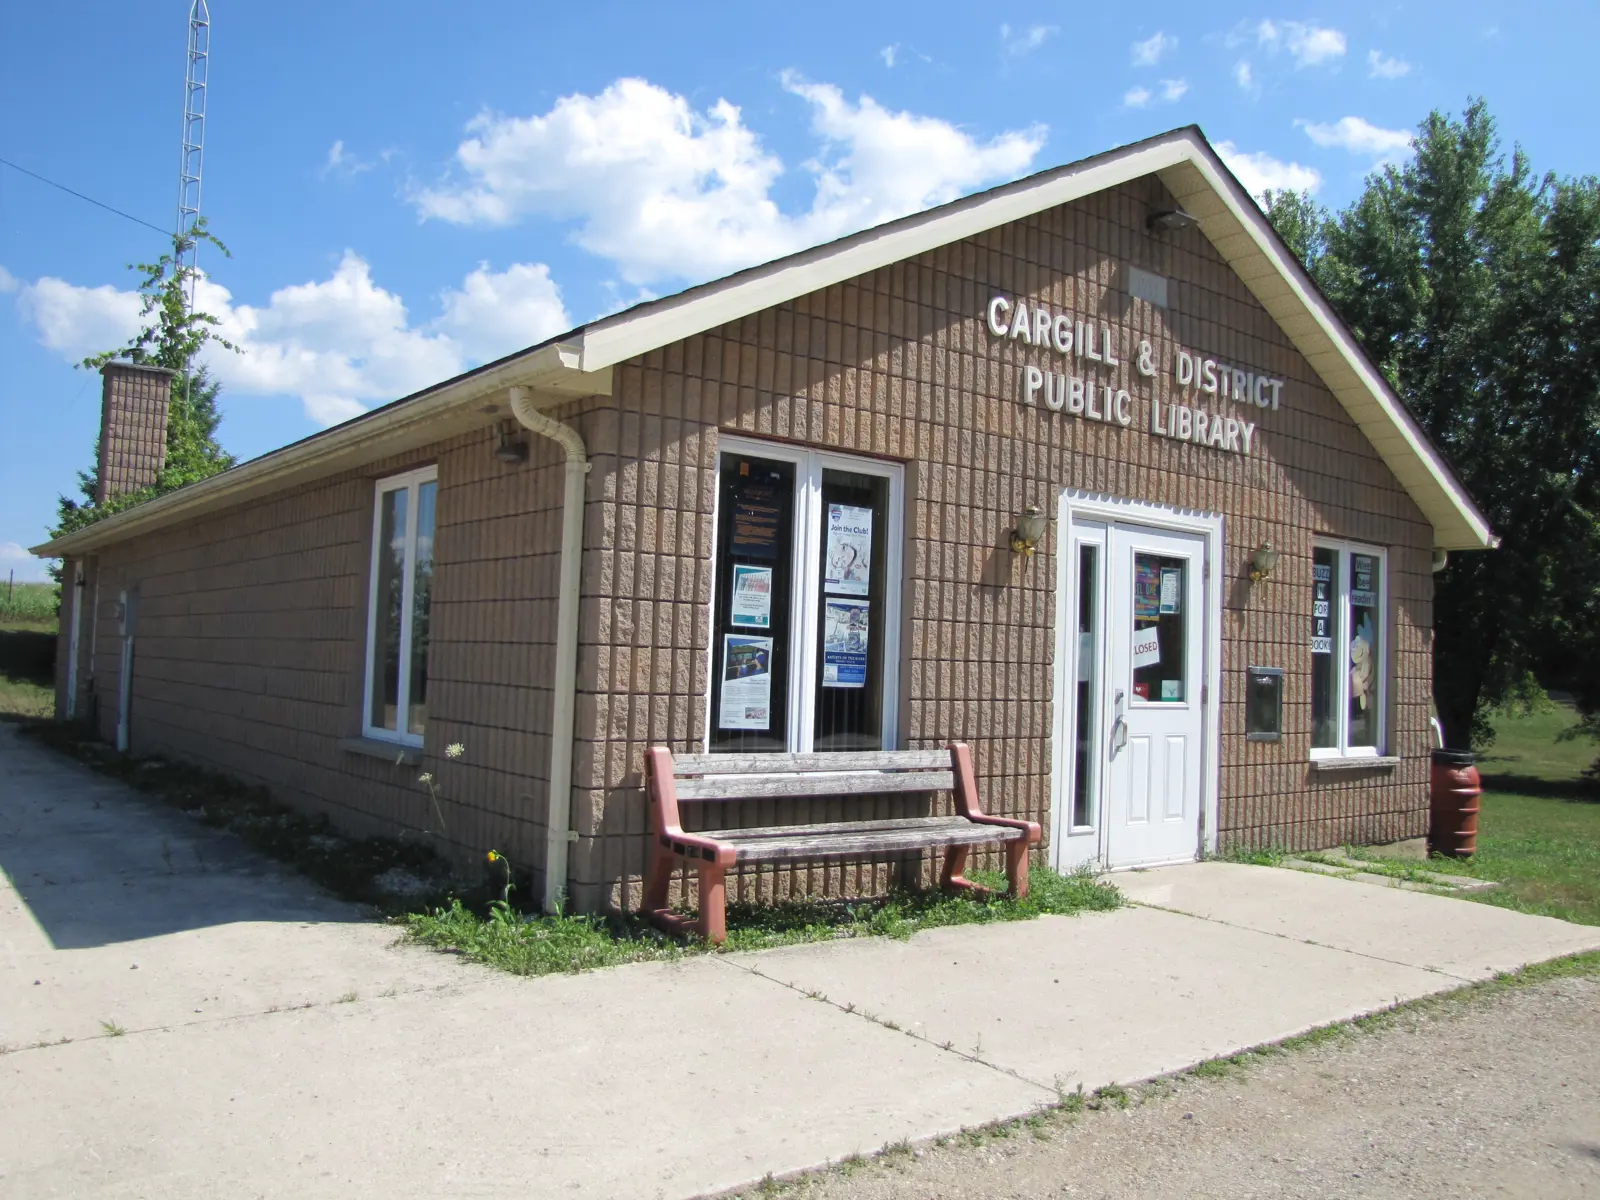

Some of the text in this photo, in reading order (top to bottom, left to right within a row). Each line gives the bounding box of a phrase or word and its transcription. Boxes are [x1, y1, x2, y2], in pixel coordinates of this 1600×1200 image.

[987, 296, 1283, 411] CARGILL & DISTRICT
[1023, 365, 1255, 454] PUBLIC LIBRARY
[831, 524, 842, 532] Join
[843, 525, 852, 533] the
[853, 526, 868, 535] Club!
[1313, 567, 1329, 579] BUZZ
[1314, 604, 1328, 614] FOR
[1317, 623, 1323, 632] A
[1134, 642, 1157, 655] LOSED
